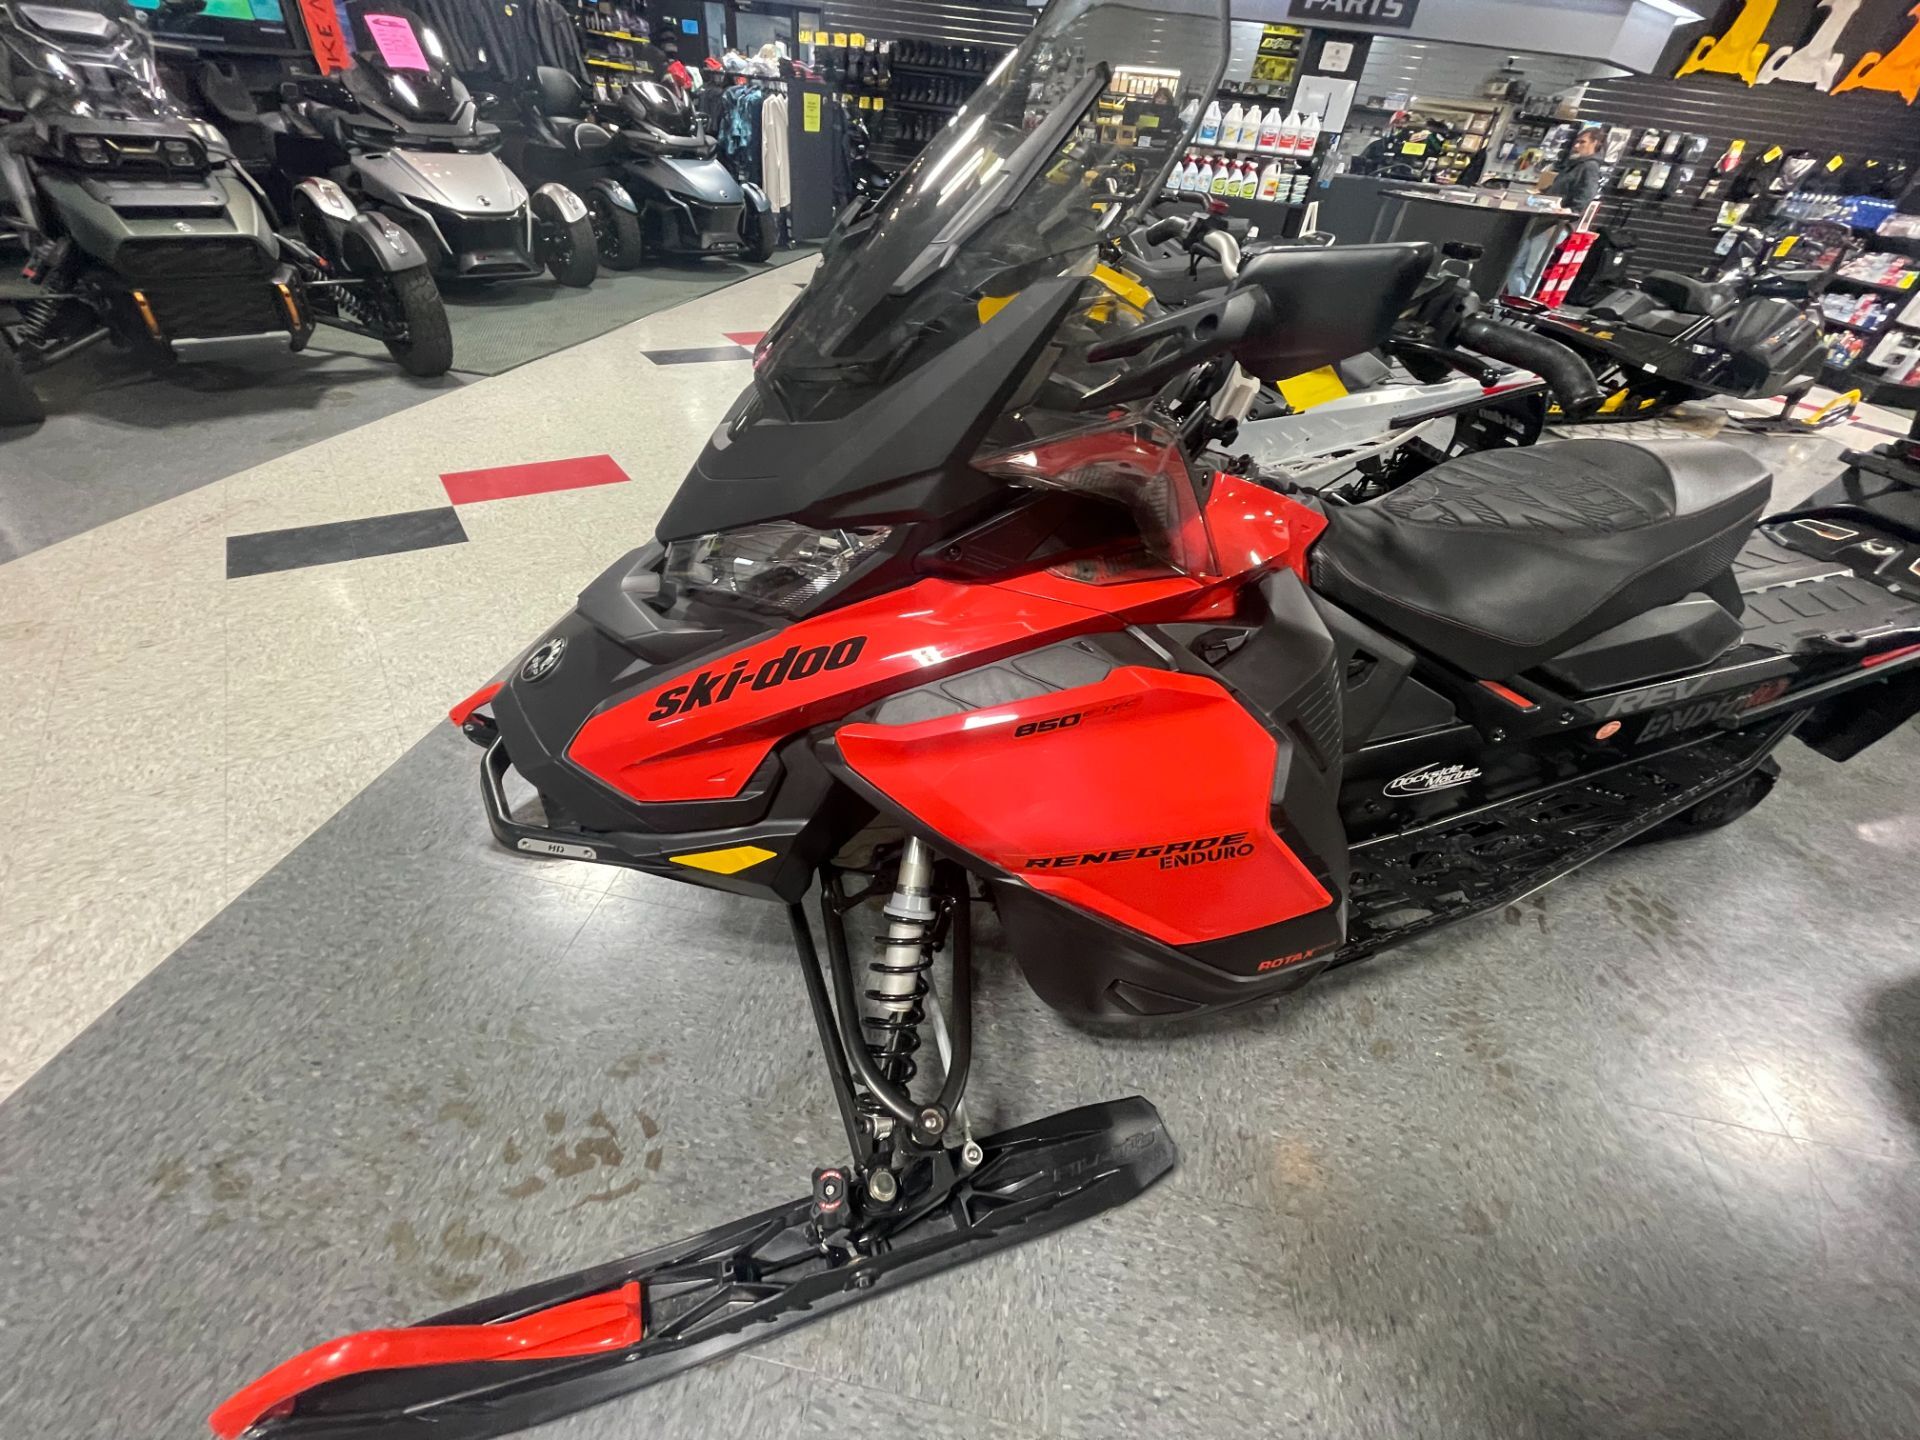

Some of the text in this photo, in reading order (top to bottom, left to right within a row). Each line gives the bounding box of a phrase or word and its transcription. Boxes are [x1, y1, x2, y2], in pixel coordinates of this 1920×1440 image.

[1605, 677, 1712, 717] REV
[1014, 713, 1082, 737] 850
[548, 844, 565, 853] HD
[1025, 832, 1249, 868] RENEGADE
[1160, 843, 1255, 869] ENDURO
[1258, 950, 1313, 971] ROTAX
